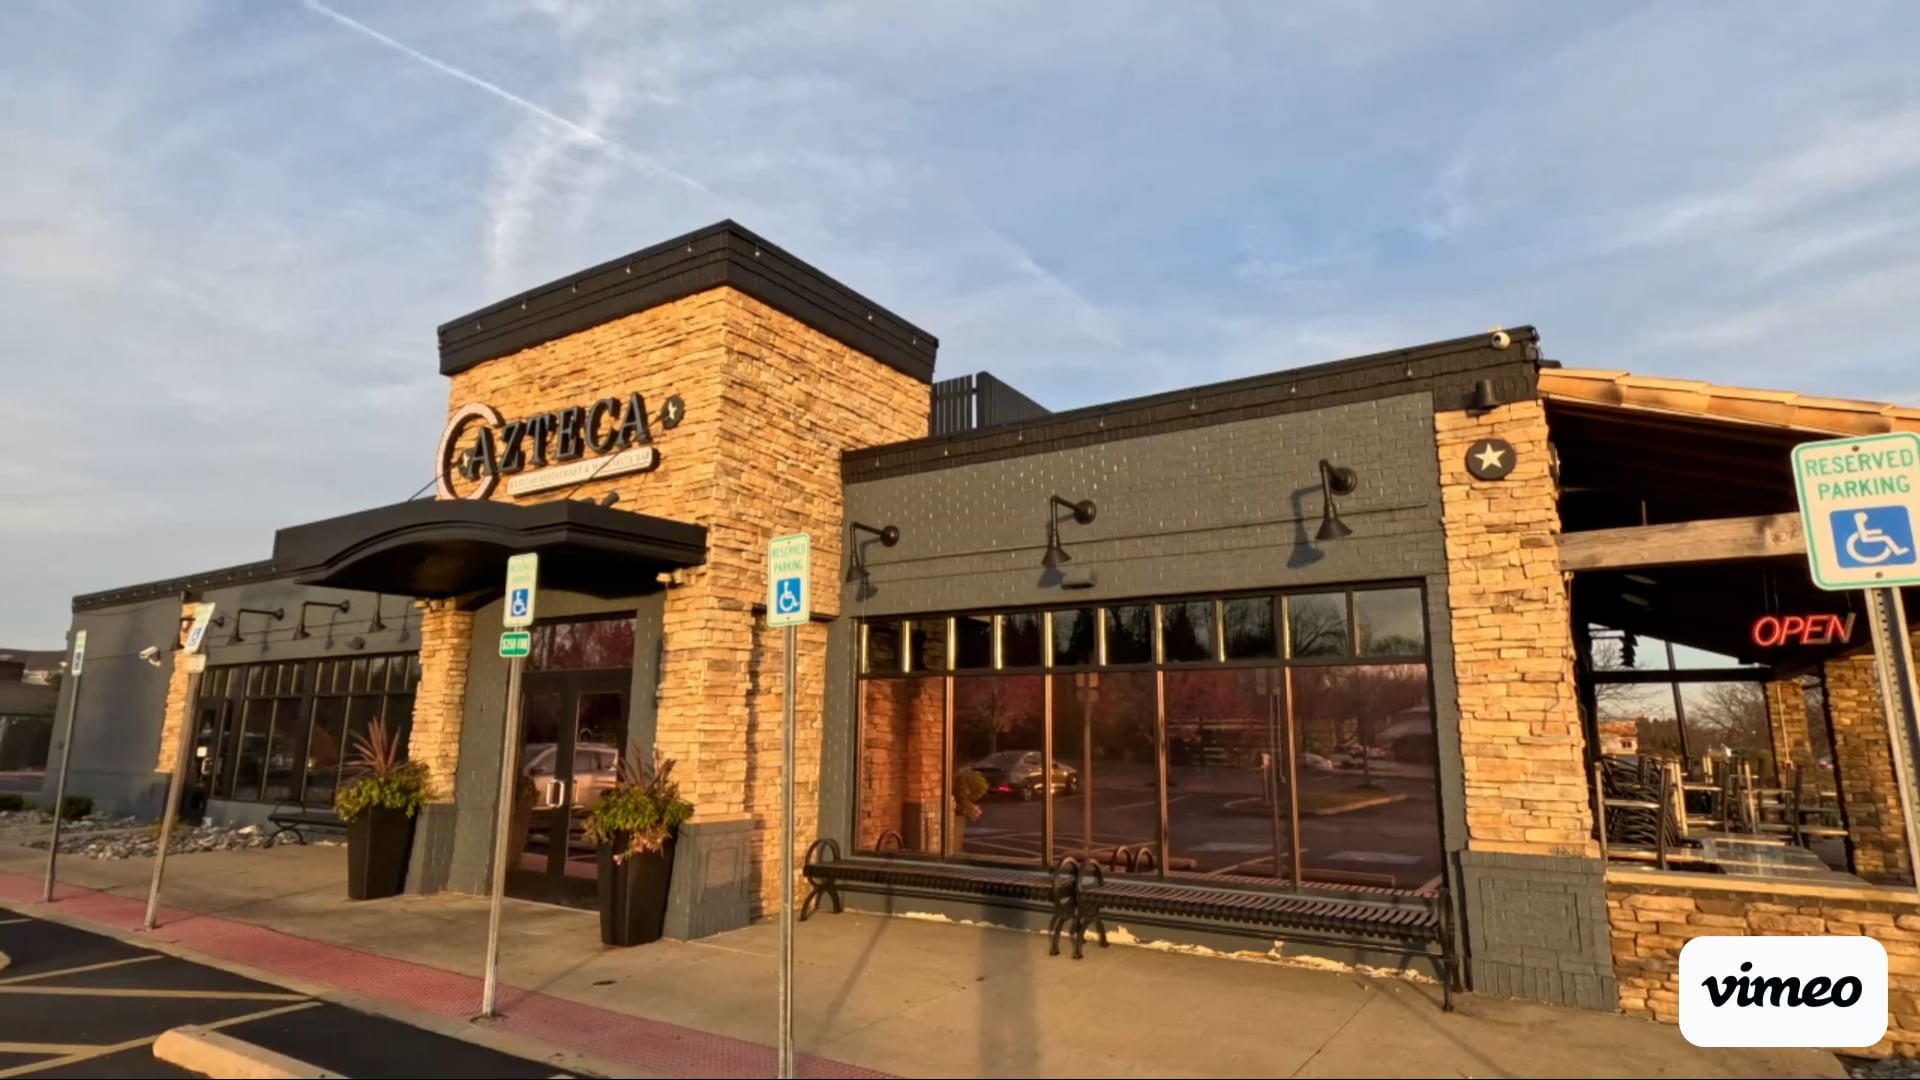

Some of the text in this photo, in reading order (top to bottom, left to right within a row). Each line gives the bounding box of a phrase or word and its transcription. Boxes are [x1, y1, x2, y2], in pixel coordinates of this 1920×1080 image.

[466, 391, 653, 480] AZTECA
[1804, 448, 1914, 477] RESERVED
[1818, 474, 1911, 501] PARKING
[1752, 612, 1857, 646] OPEN
